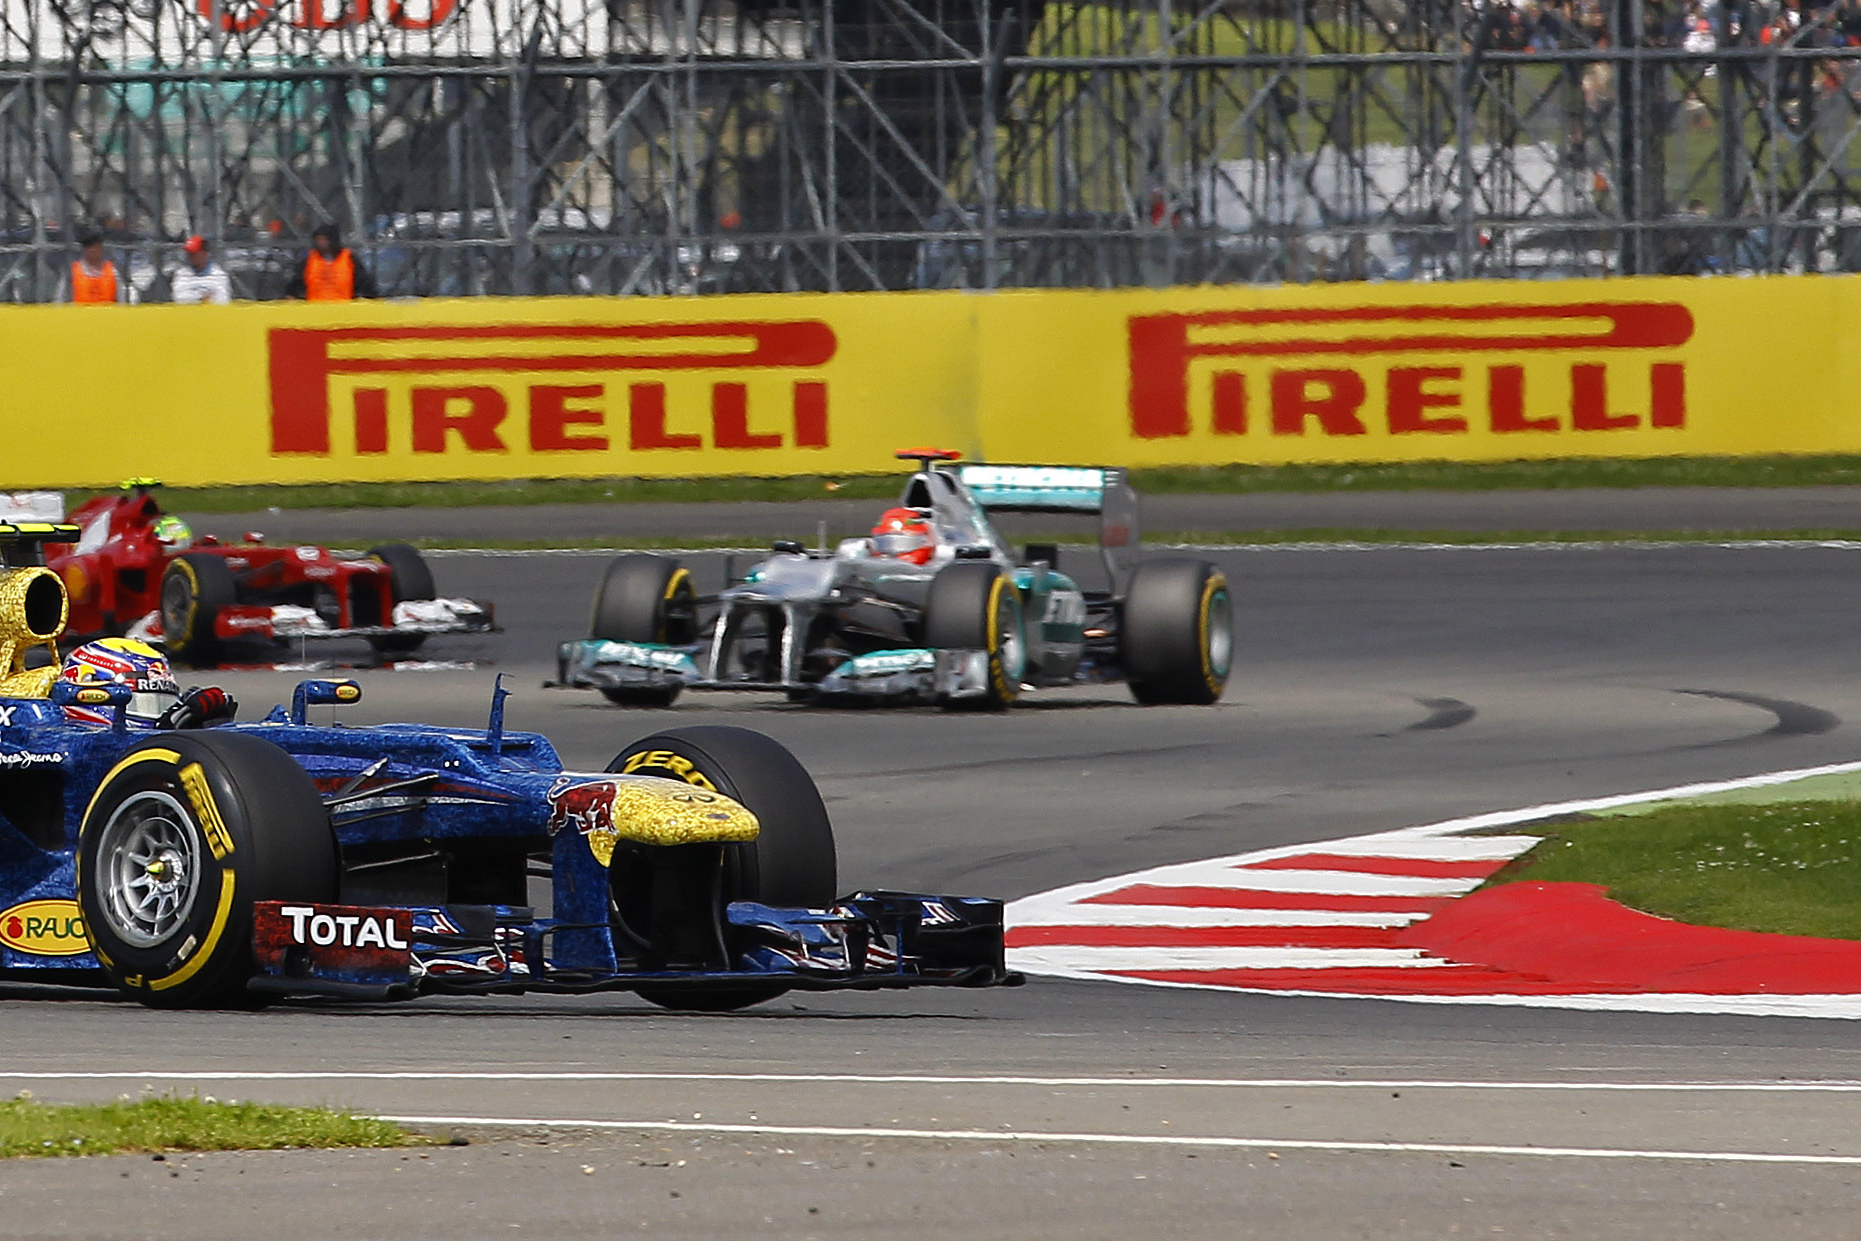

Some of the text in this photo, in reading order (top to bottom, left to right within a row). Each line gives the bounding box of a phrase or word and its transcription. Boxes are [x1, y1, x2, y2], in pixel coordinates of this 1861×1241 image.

[269, 319, 837, 454] PIRELLI
[1128, 302, 1694, 437] PIRELLI
[26, 917, 87, 939] RAUC
[281, 906, 408, 950] TOTAL
